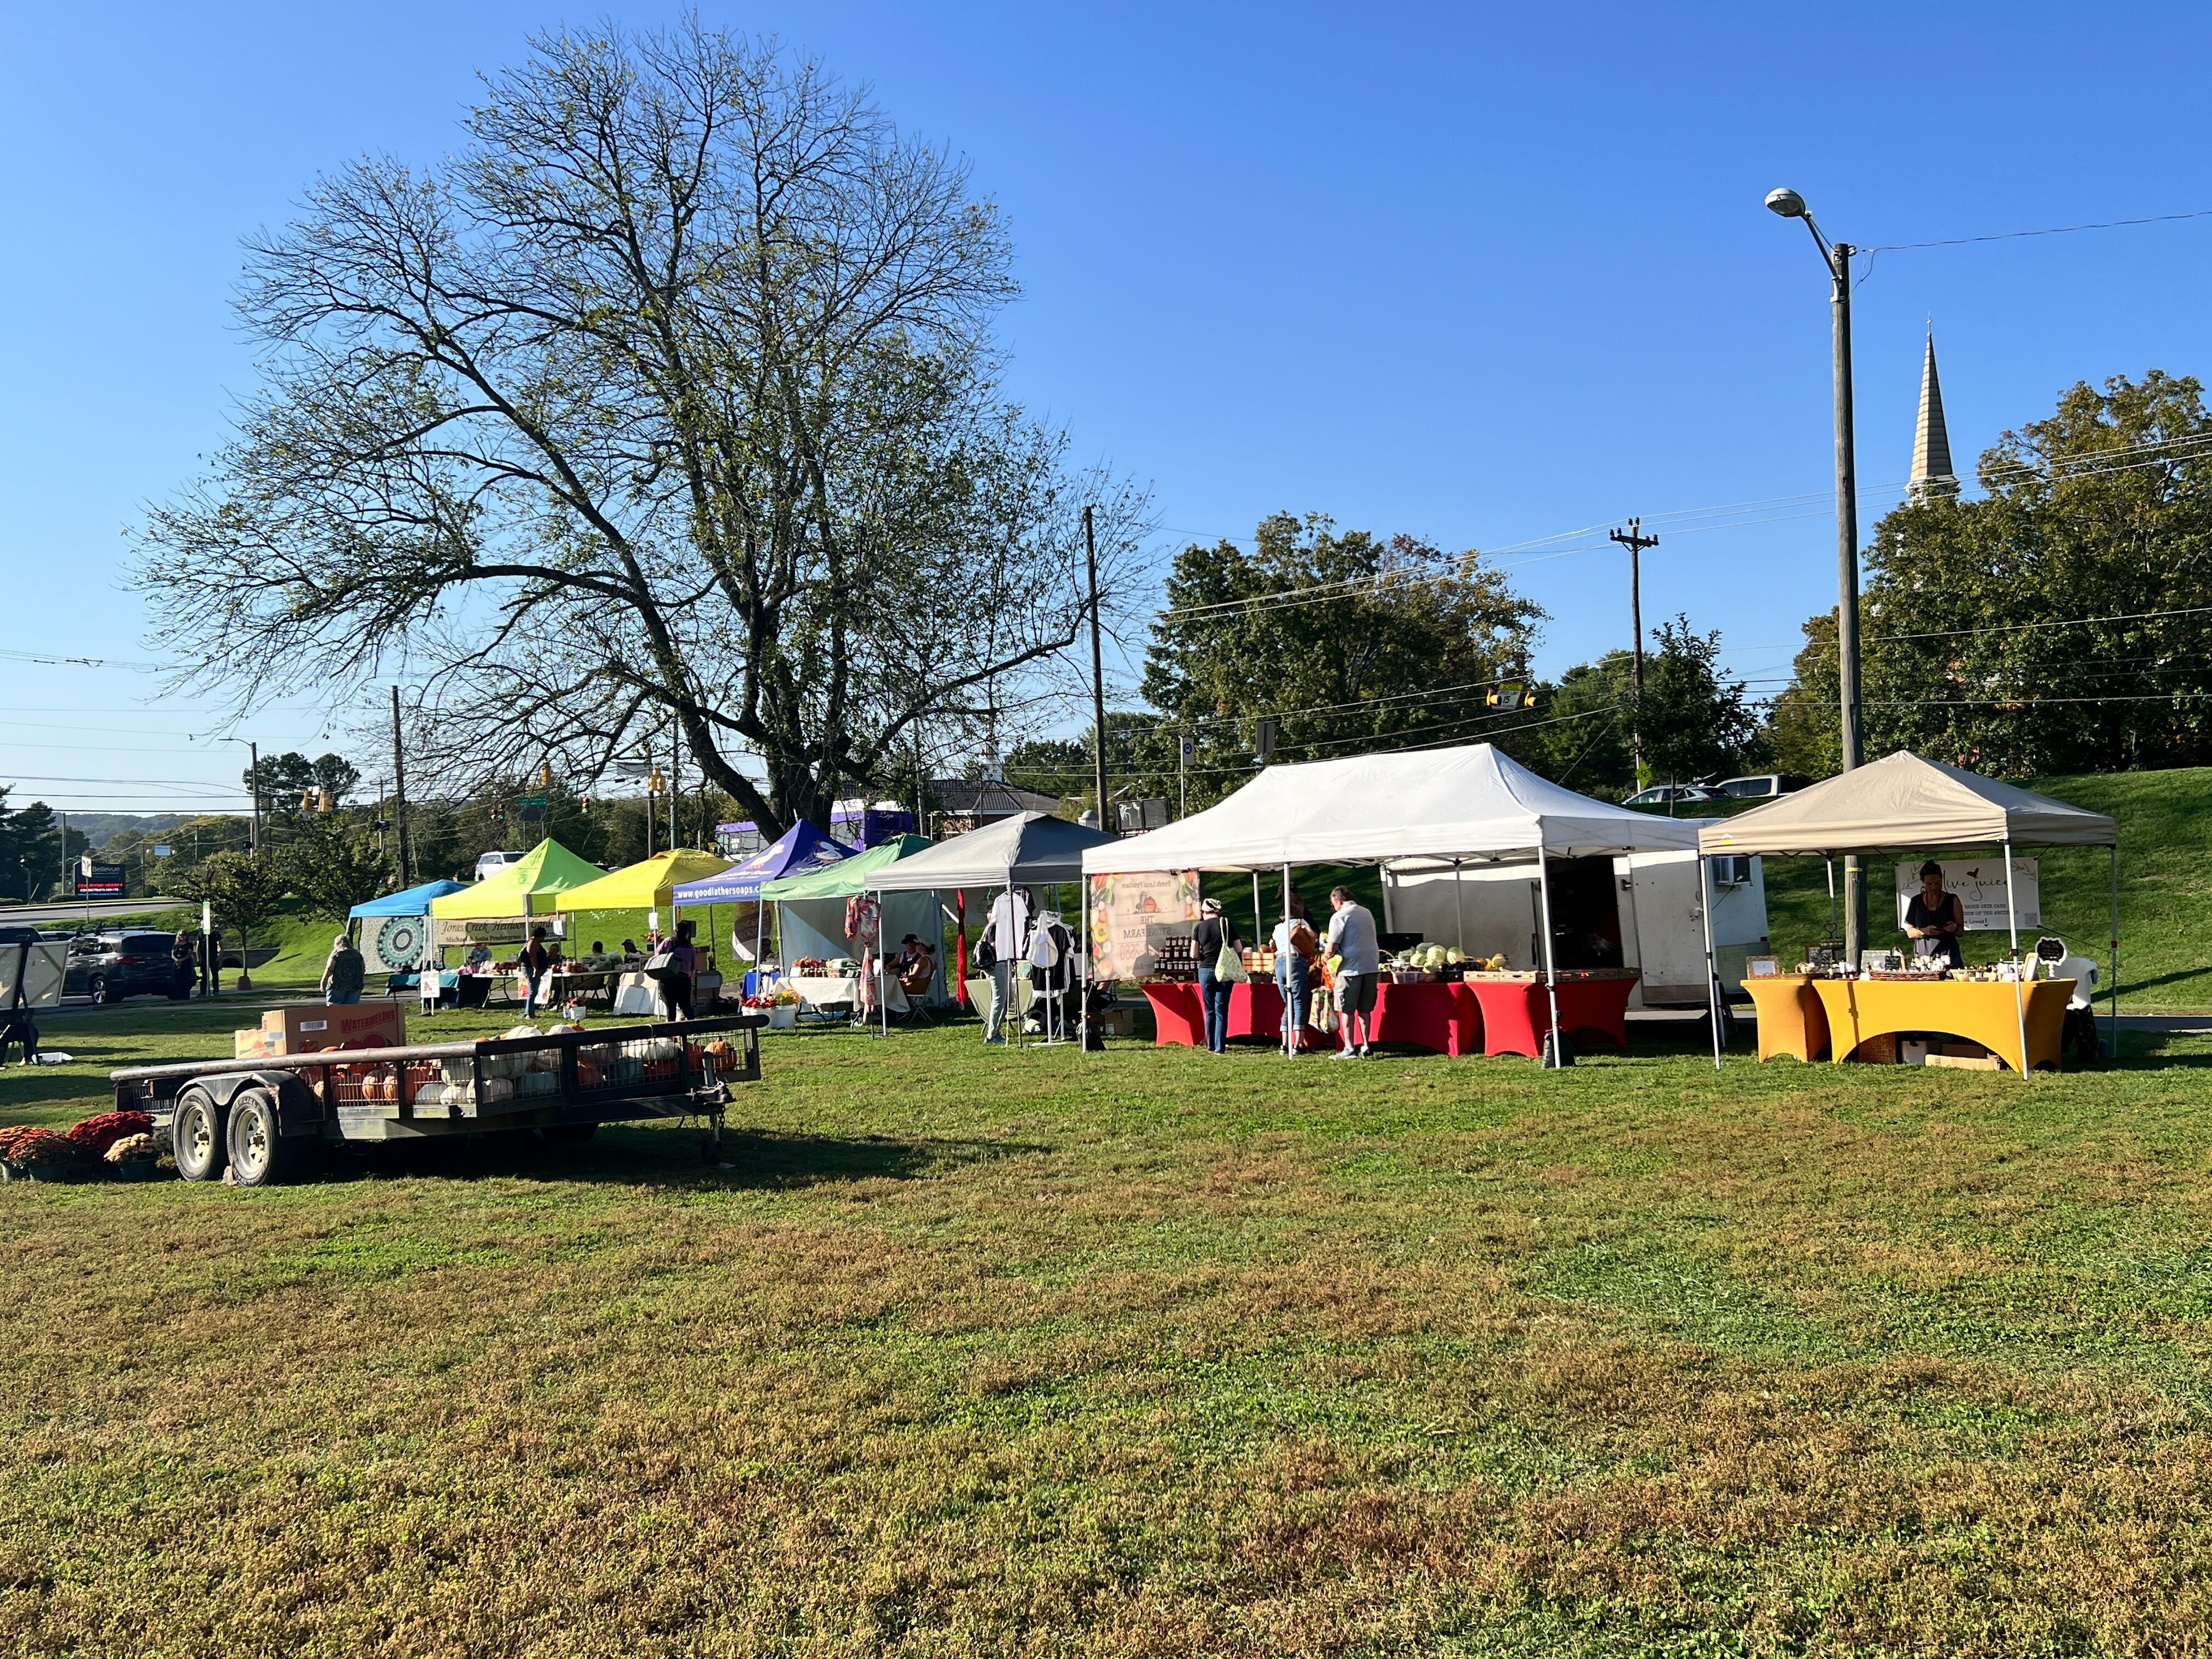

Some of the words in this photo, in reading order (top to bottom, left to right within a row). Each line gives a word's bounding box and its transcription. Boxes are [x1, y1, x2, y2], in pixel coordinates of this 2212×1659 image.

[678, 885, 760, 899] www.goodlathersoaps.c
[441, 921, 464, 934] Jones
[465, 919, 489, 934] Creek
[491, 919, 526, 932] Heirloom
[531, 916, 554, 929] Garde
[341, 1011, 396, 1032] WATERMELONS
